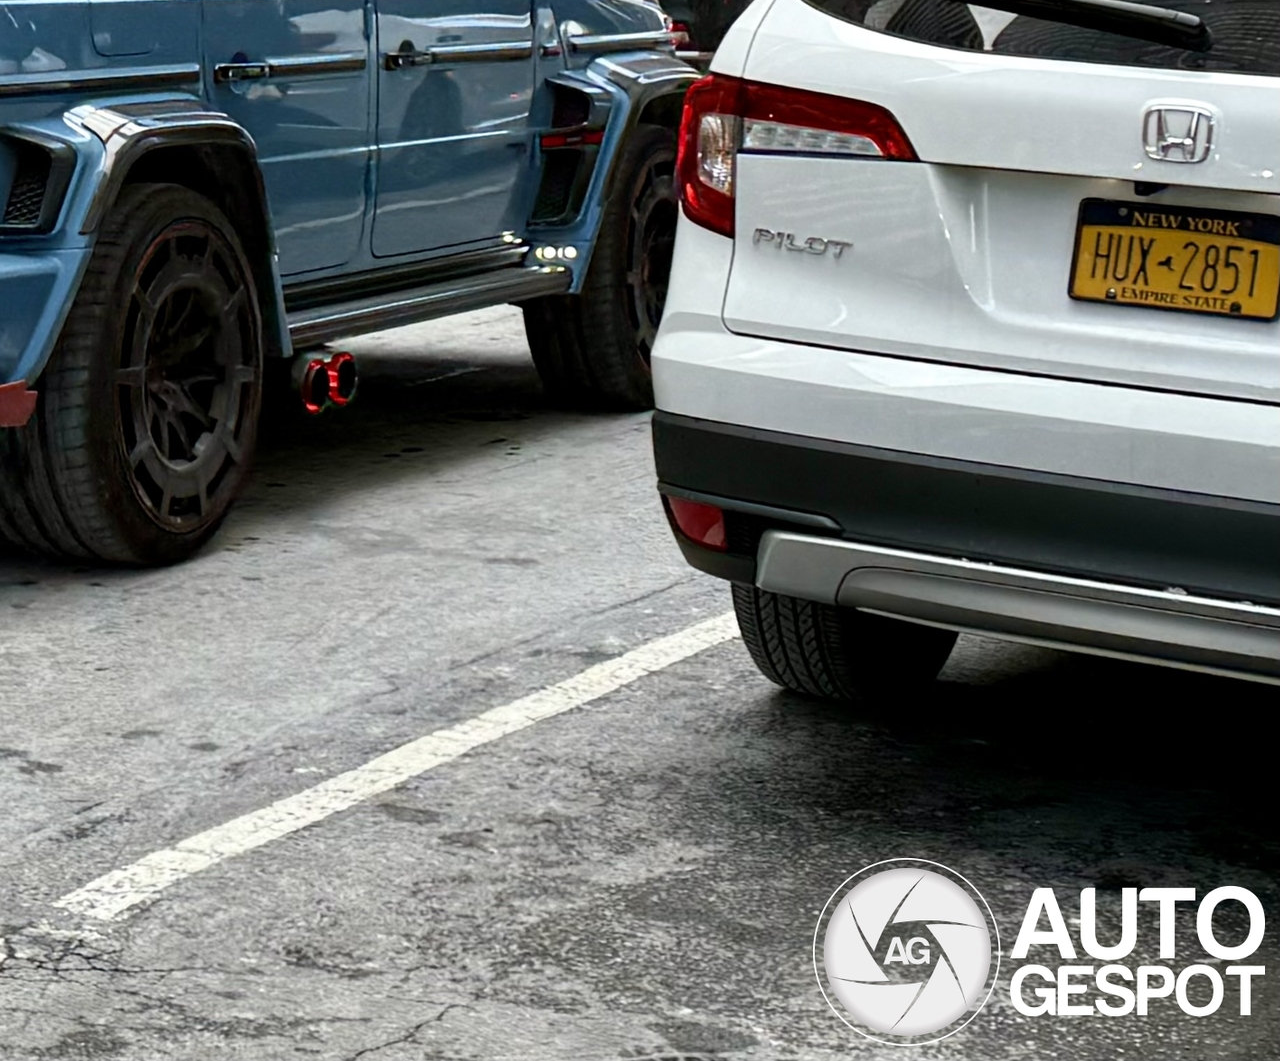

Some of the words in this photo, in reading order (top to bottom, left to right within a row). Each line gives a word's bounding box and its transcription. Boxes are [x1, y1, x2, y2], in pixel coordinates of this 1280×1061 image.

[1131, 211, 1182, 230] NEW
[1187, 216, 1241, 237] YORK
[752, 227, 854, 259] PILOT
[1090, 231, 1157, 287] HUX
[1178, 241, 1261, 298] 2851
[1120, 287, 1179, 305] EMPIRE
[1183, 295, 1230, 311] STATE
